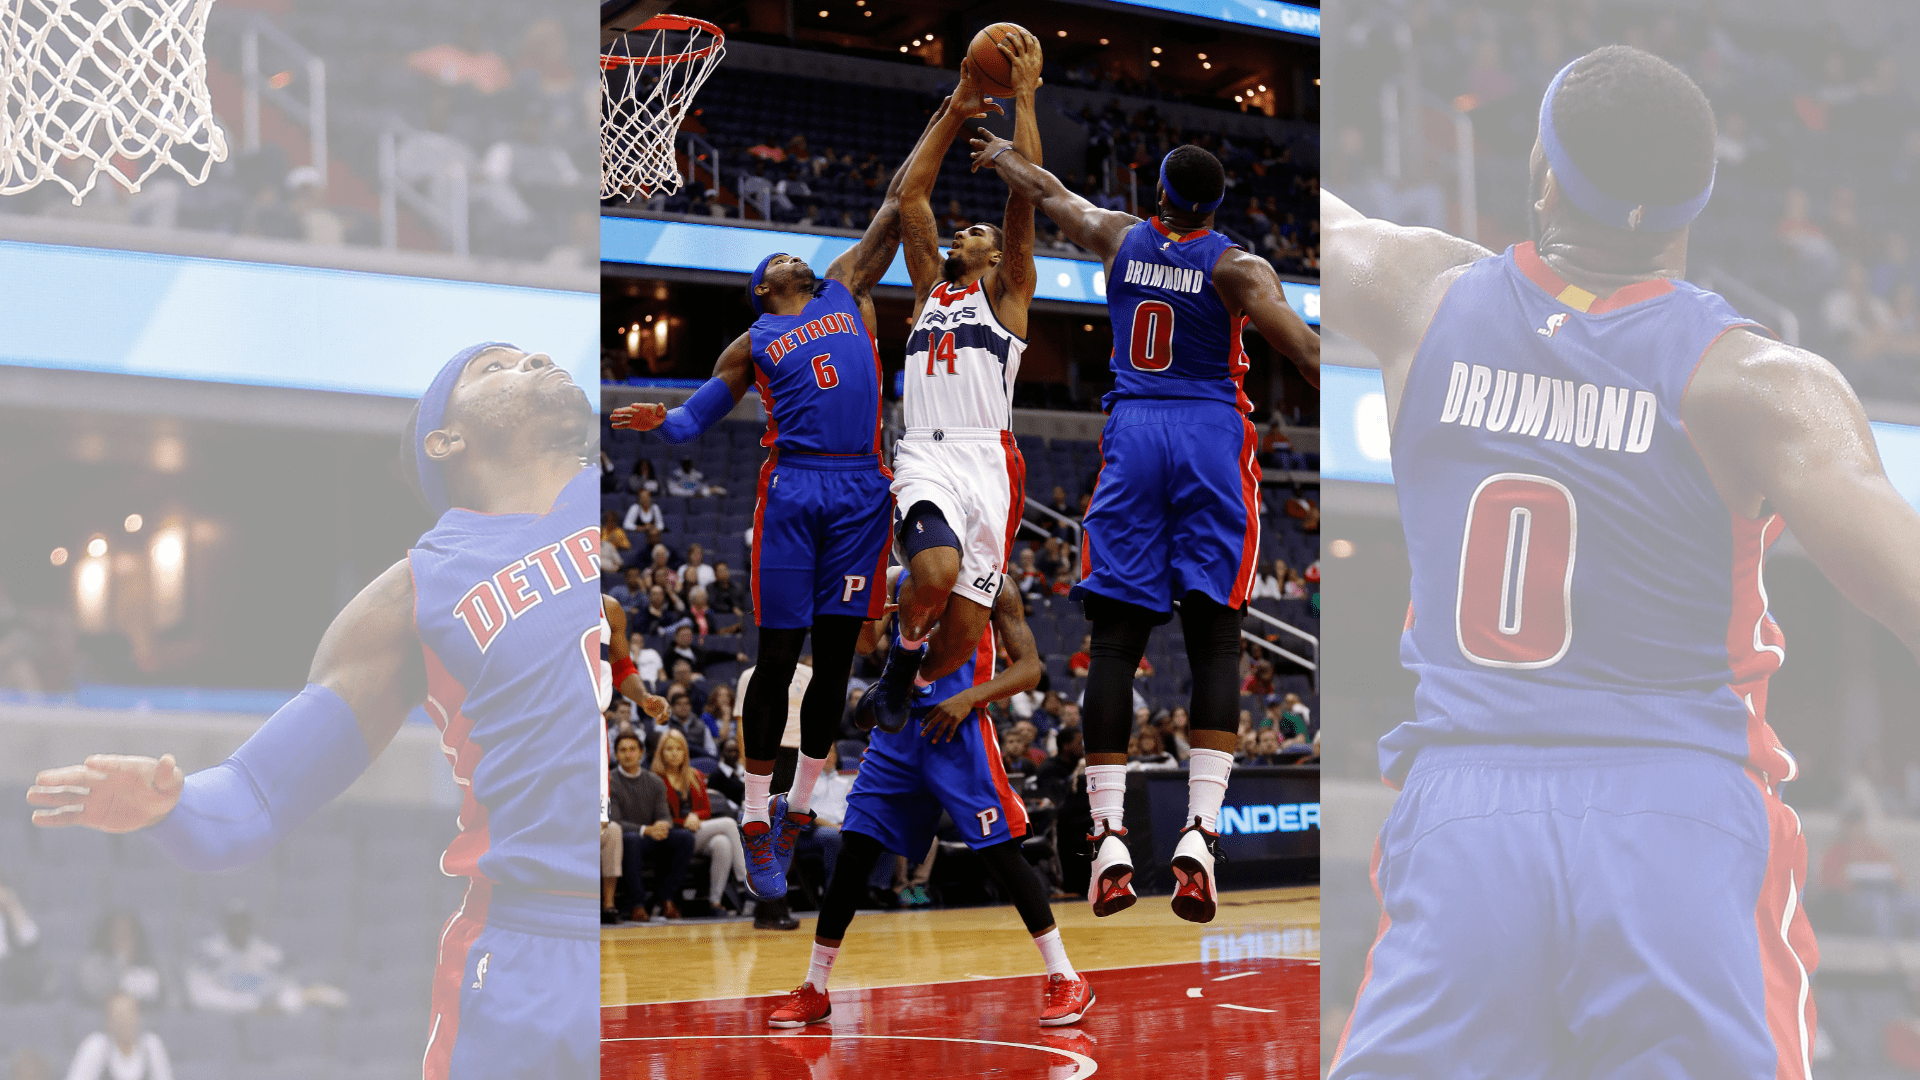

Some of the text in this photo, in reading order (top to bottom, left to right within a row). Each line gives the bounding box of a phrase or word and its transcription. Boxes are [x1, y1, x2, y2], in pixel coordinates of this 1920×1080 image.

[1124, 259, 1204, 294] DRUMMOND
[765, 312, 859, 366] DETROIT
[926, 331, 960, 377] 14
[1130, 299, 1175, 372] 0
[811, 353, 839, 390] 6
[1440, 361, 1658, 454] DRUMMOND
[453, 525, 600, 654] DETR
[843, 574, 866, 602] P
[1455, 472, 1578, 670] 0
[976, 806, 999, 837] P
